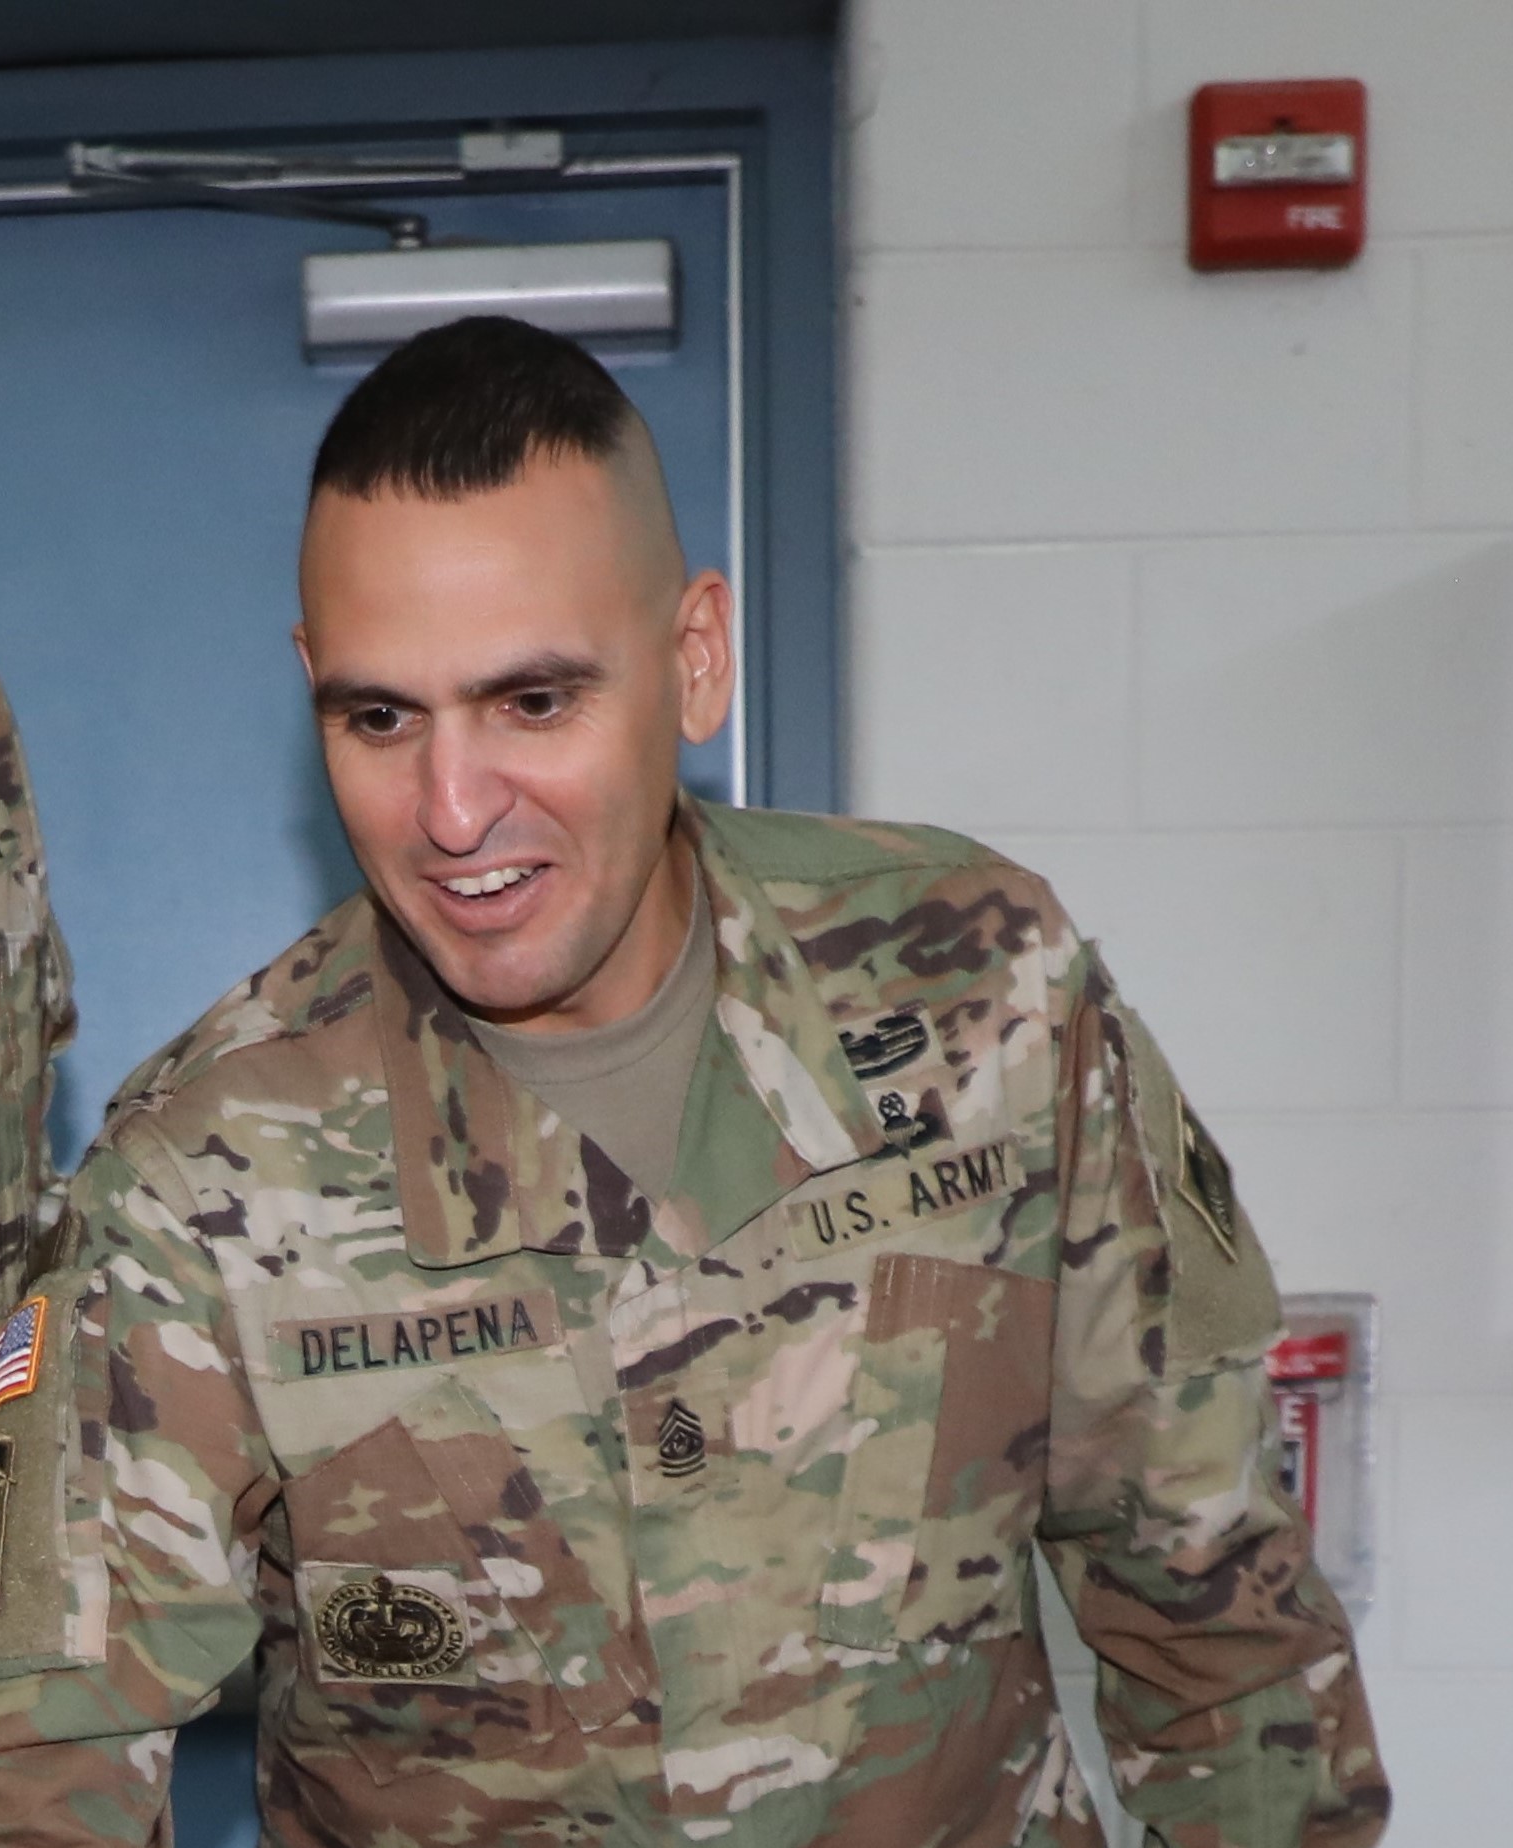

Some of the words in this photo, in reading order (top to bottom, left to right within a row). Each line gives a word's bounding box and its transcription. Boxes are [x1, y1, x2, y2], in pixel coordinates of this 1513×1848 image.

[1286, 203, 1344, 231] FIRE
[811, 1191, 891, 1245] U.S.
[909, 1142, 1008, 1218] ARMY
[300, 1298, 538, 1377] DELAPENA
